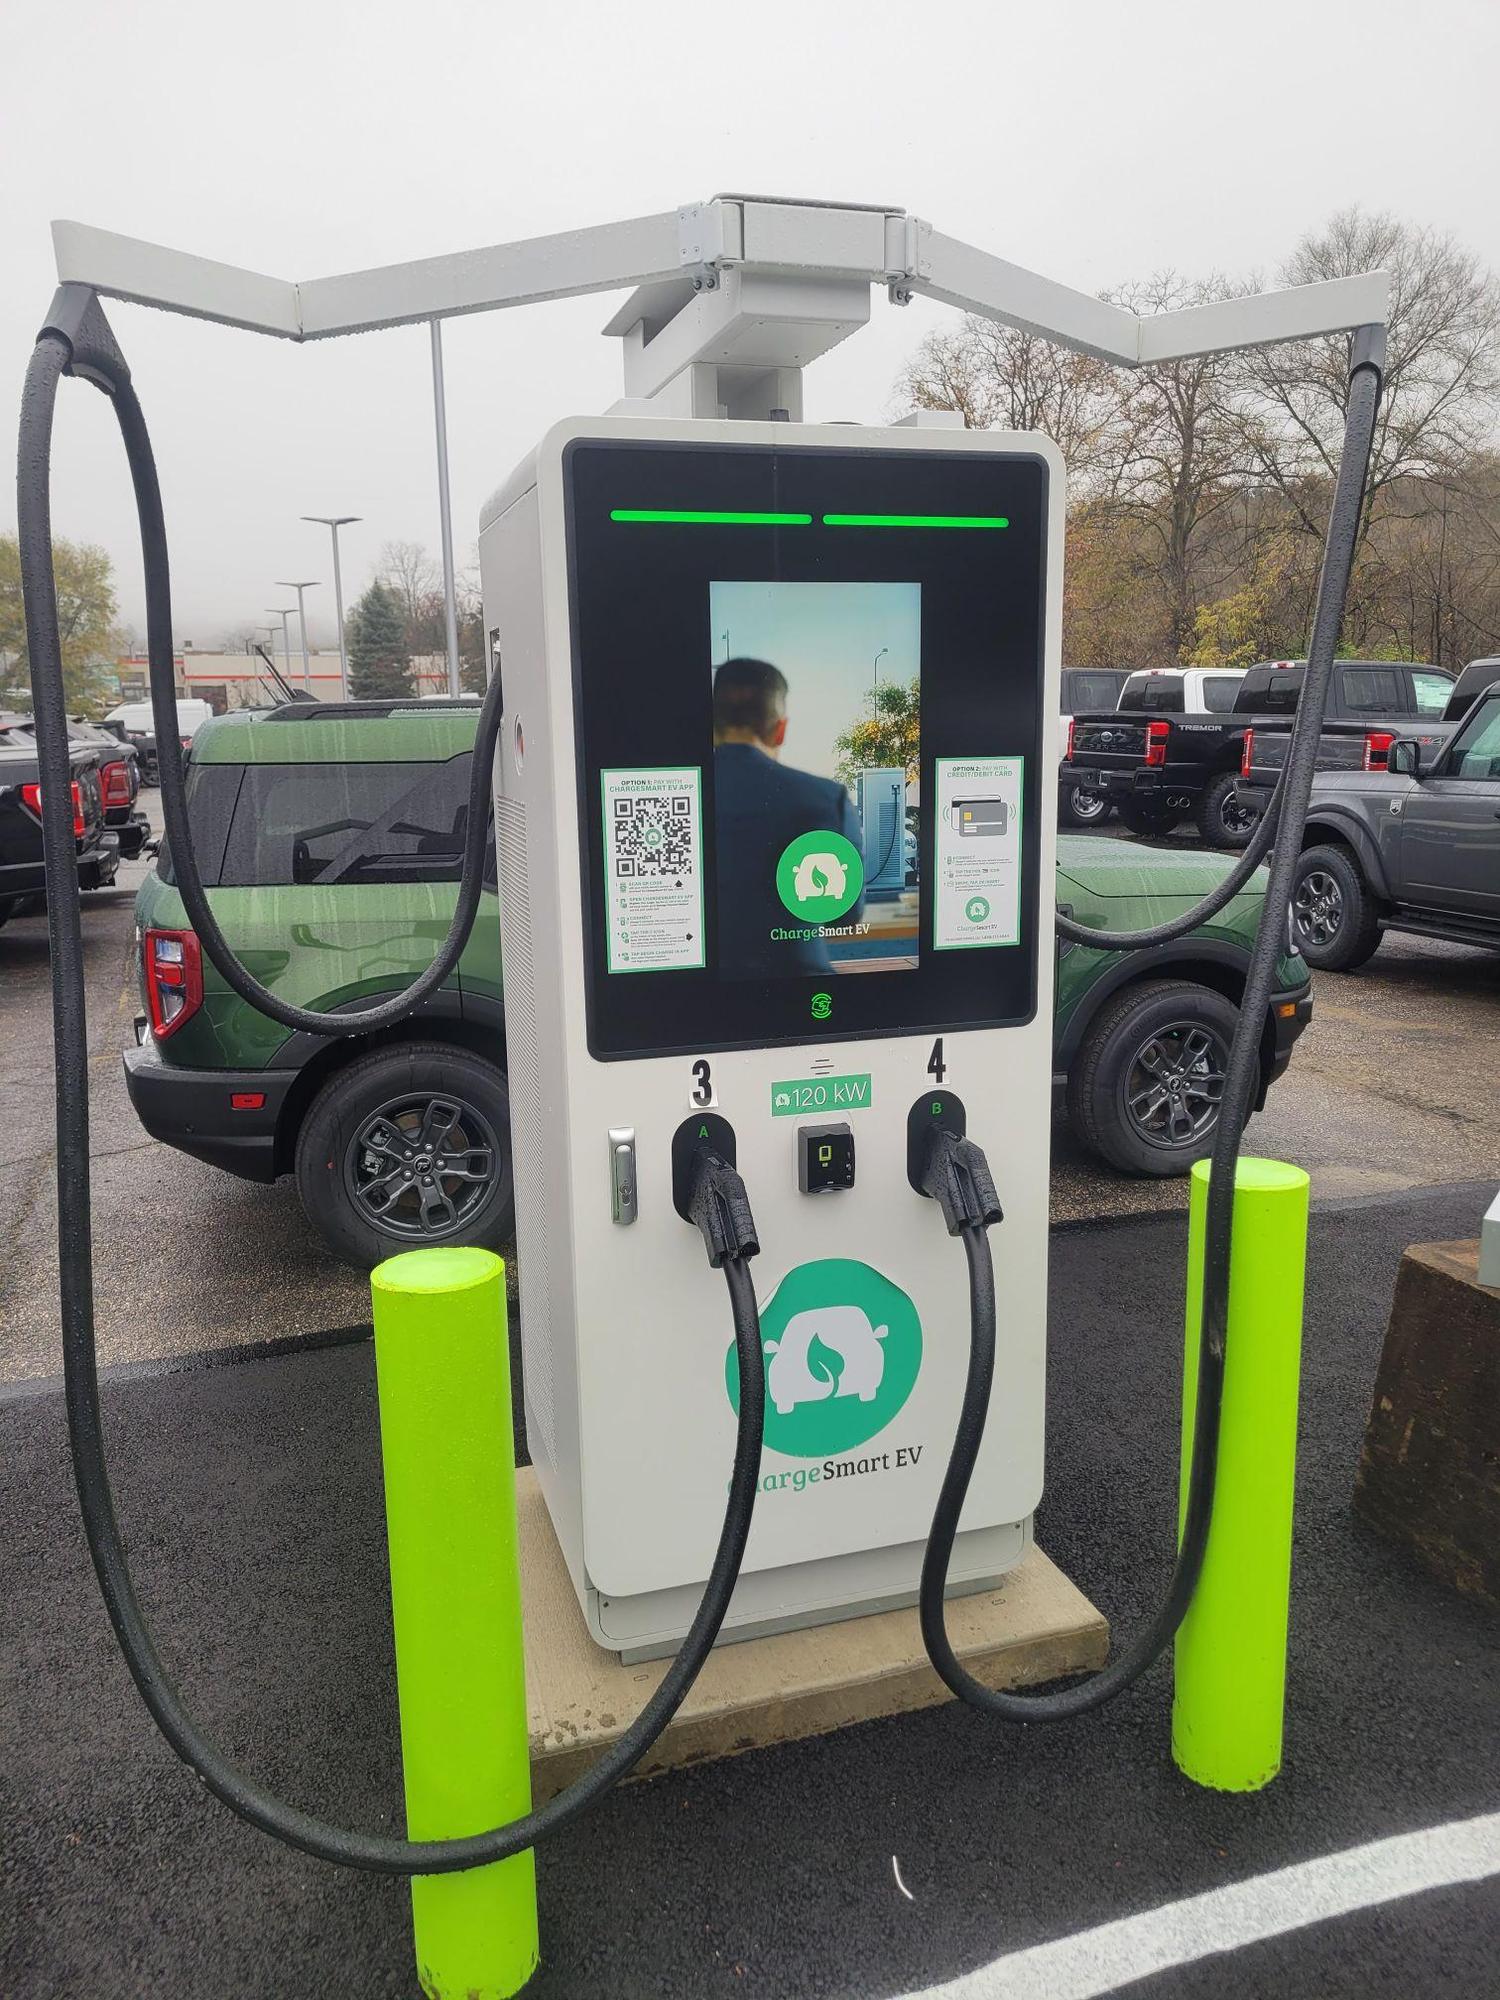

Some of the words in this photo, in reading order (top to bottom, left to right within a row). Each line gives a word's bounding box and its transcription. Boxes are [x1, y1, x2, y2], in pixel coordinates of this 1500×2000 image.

[609, 785, 666, 793] CHARGESMART
[770, 925, 853, 941] ChargeSmart
[855, 923, 871, 935] EV
[927, 1037, 947, 1084] 4
[692, 1059, 713, 1107] 3
[792, 1086, 828, 1107] 120
[834, 1081, 868, 1104] kW
[932, 1102, 942, 1115] B
[699, 1125, 709, 1138] A
[728, 1453, 890, 1495] argeSmart
[895, 1446, 924, 1468] EV
